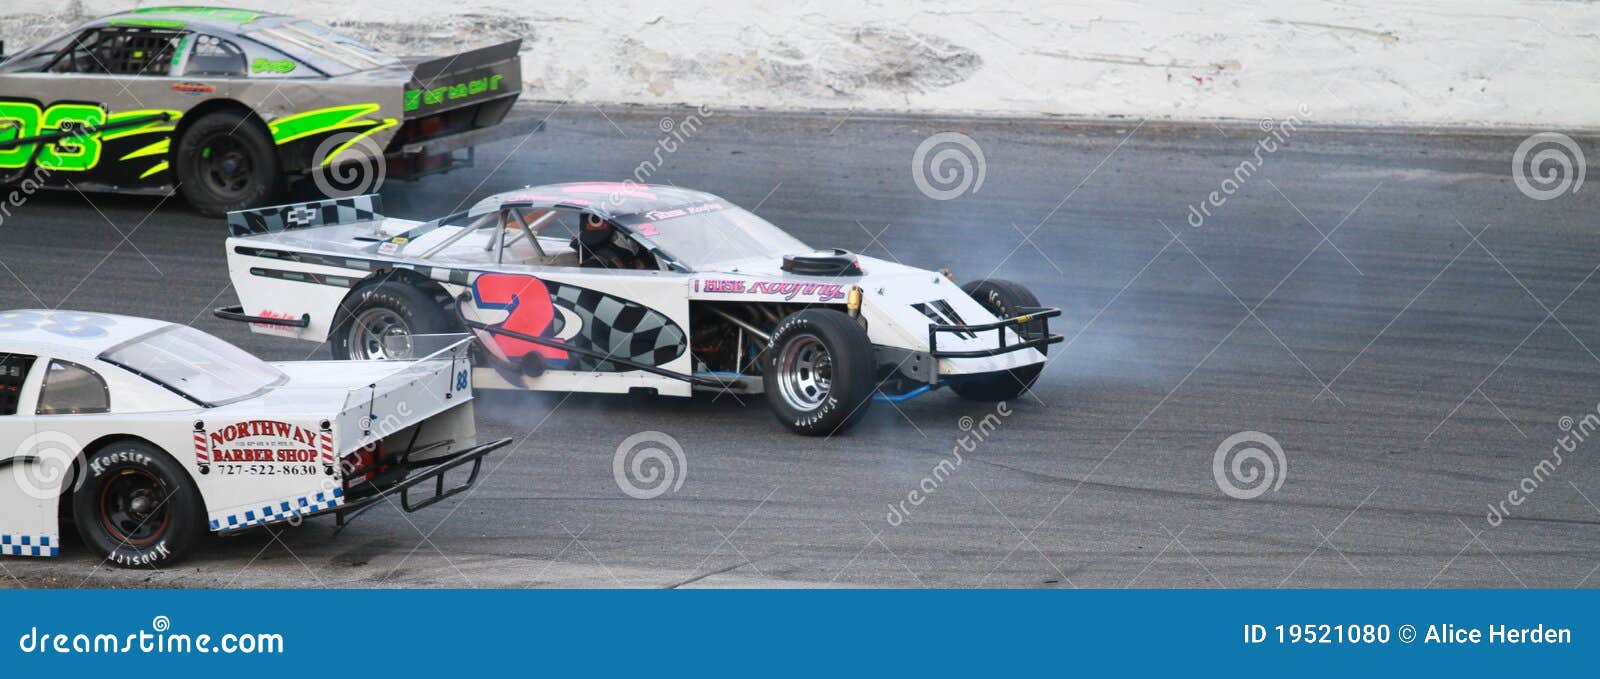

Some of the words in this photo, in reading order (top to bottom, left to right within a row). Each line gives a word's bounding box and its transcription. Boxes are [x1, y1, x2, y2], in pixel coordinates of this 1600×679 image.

[471, 271, 573, 368] 2
[456, 368, 469, 392] 88
[209, 419, 317, 449] NORTHWAY
[89, 449, 152, 477] Hoosier
[212, 448, 275, 462] BARBER
[276, 449, 319, 463] SHOP
[218, 464, 317, 476] 727-522-8630
